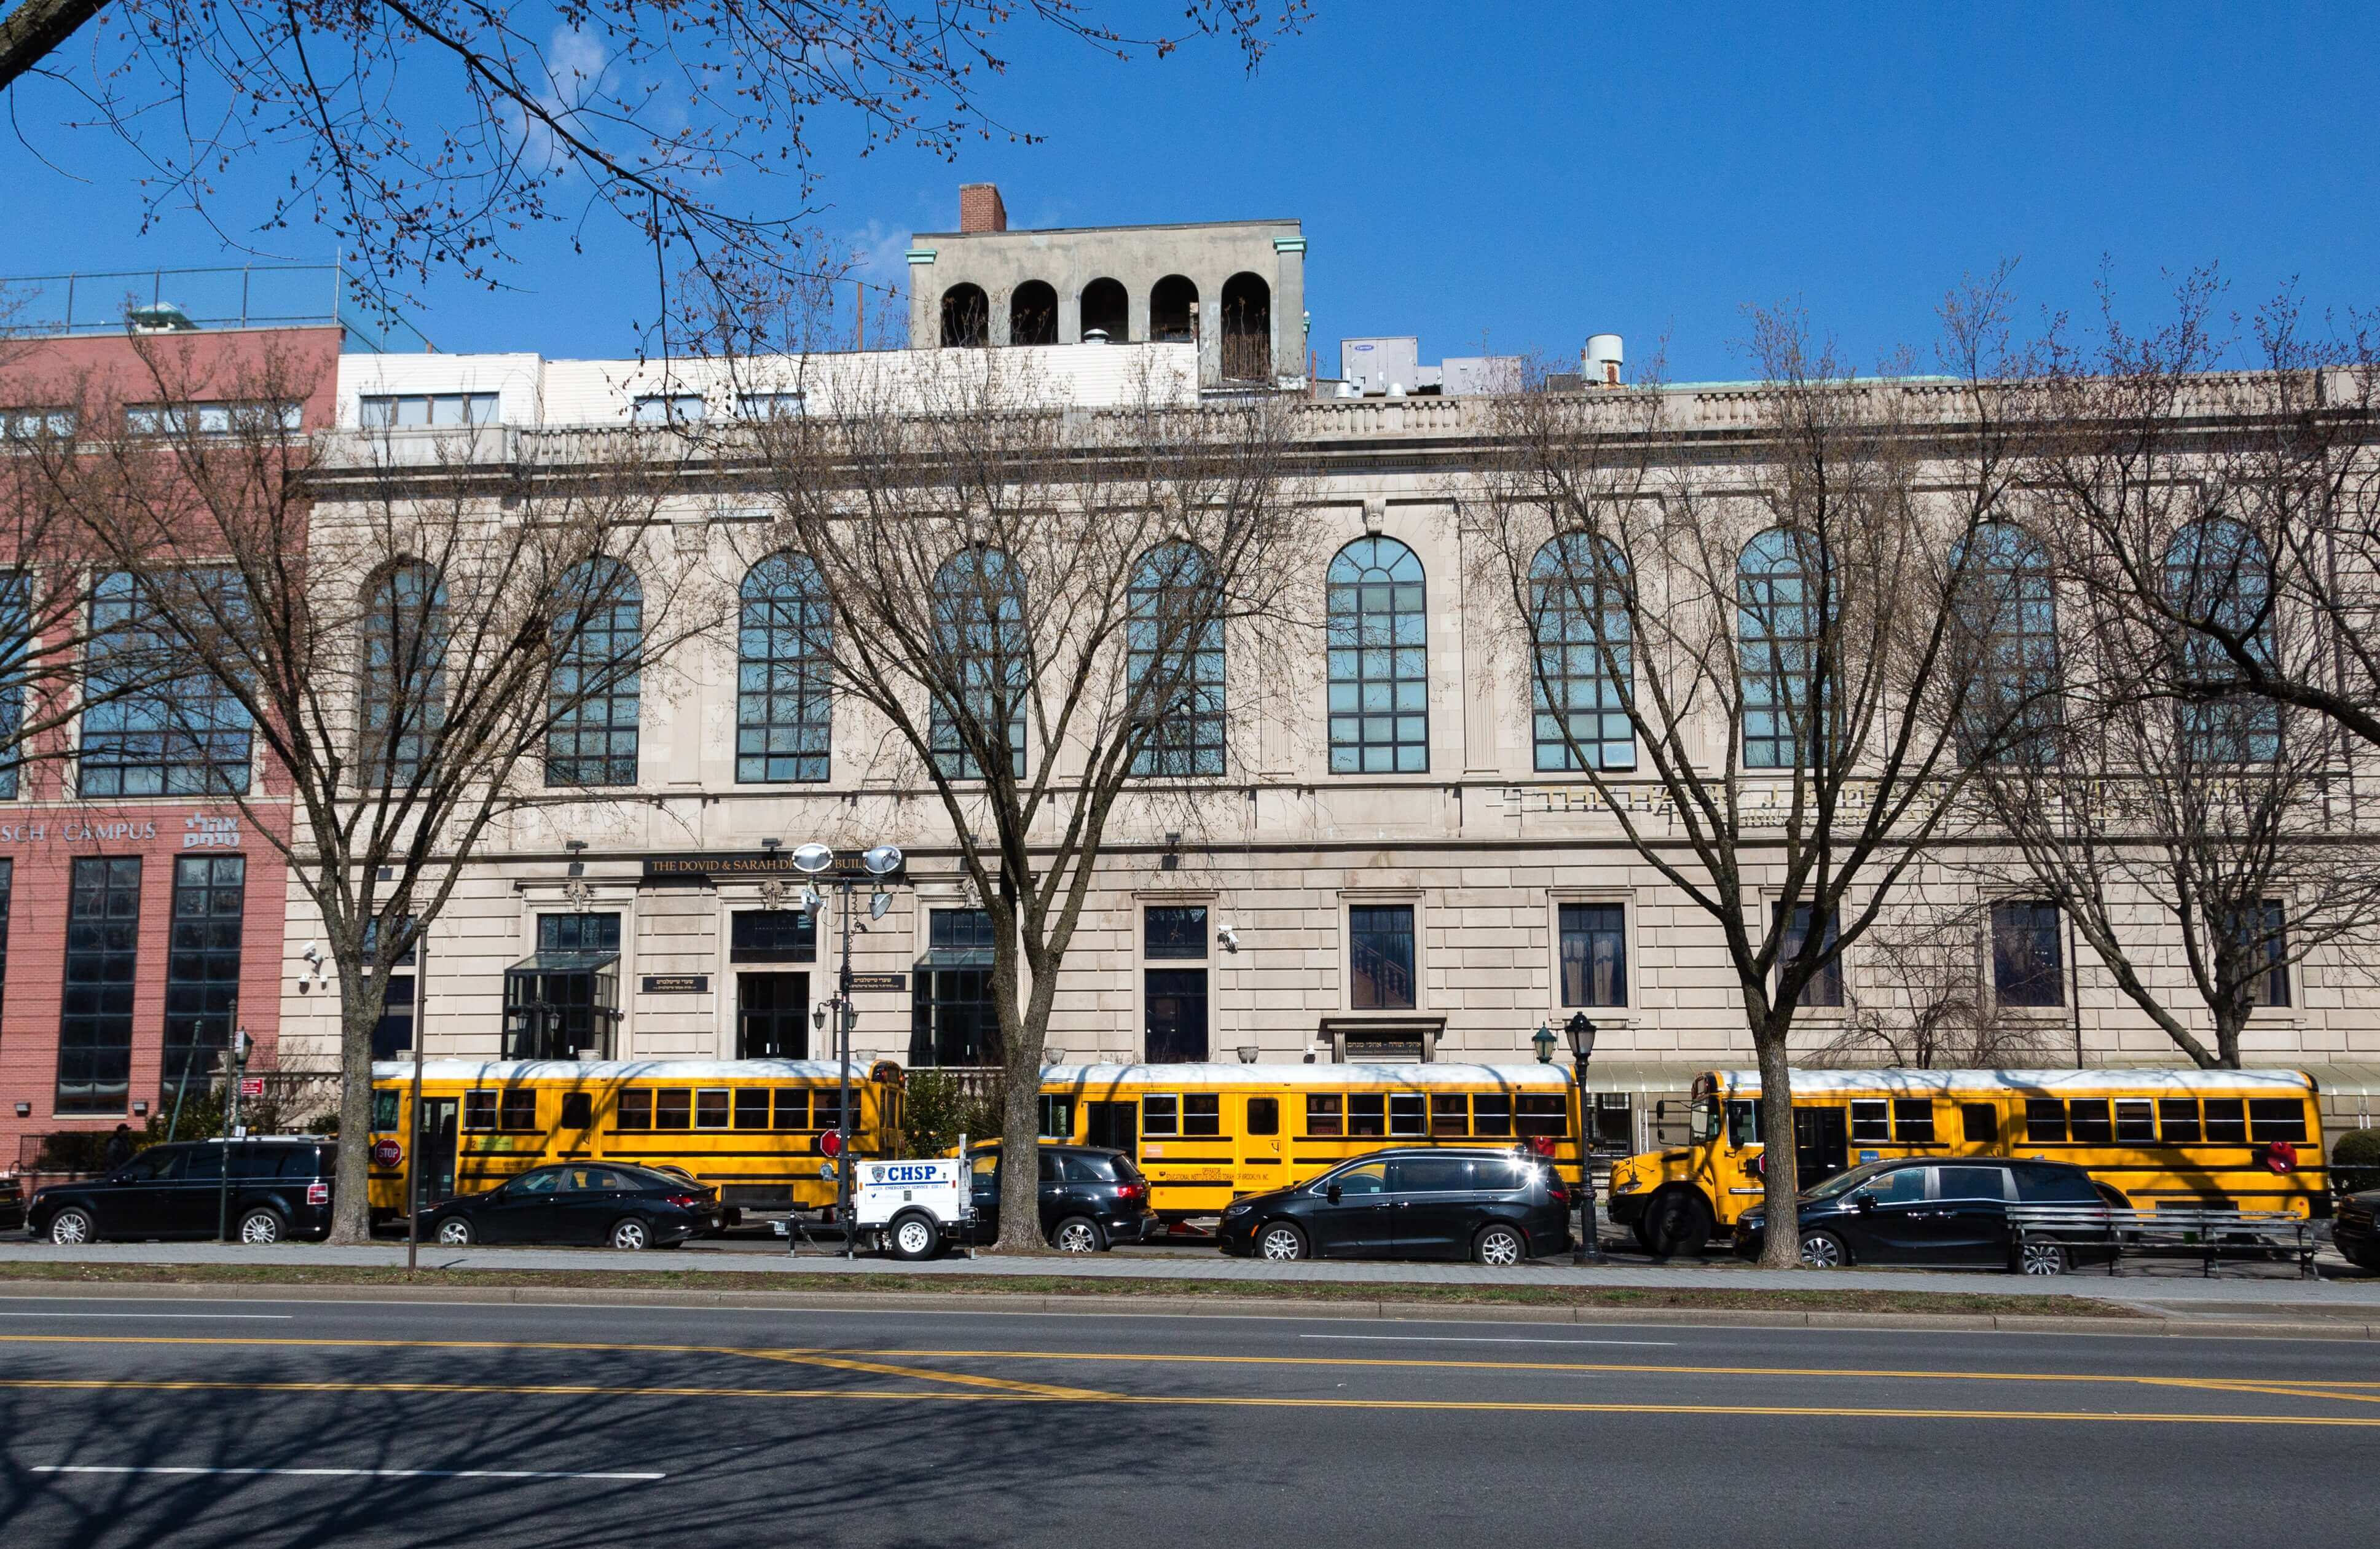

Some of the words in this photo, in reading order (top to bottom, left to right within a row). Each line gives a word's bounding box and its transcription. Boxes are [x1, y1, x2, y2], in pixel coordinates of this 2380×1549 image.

[185, 811, 240, 832] אהלי
[1, 825, 44, 842] SCH
[63, 822, 156, 842] CAMPUS
[184, 831, 240, 849] מנחם
[652, 861, 676, 871] THE
[678, 860, 718, 871] DOVID
[721, 860, 731, 870] &
[733, 860, 776, 870] SARAH
[379, 1148, 398, 1158] STOP
[888, 1166, 937, 1181] CHSP
